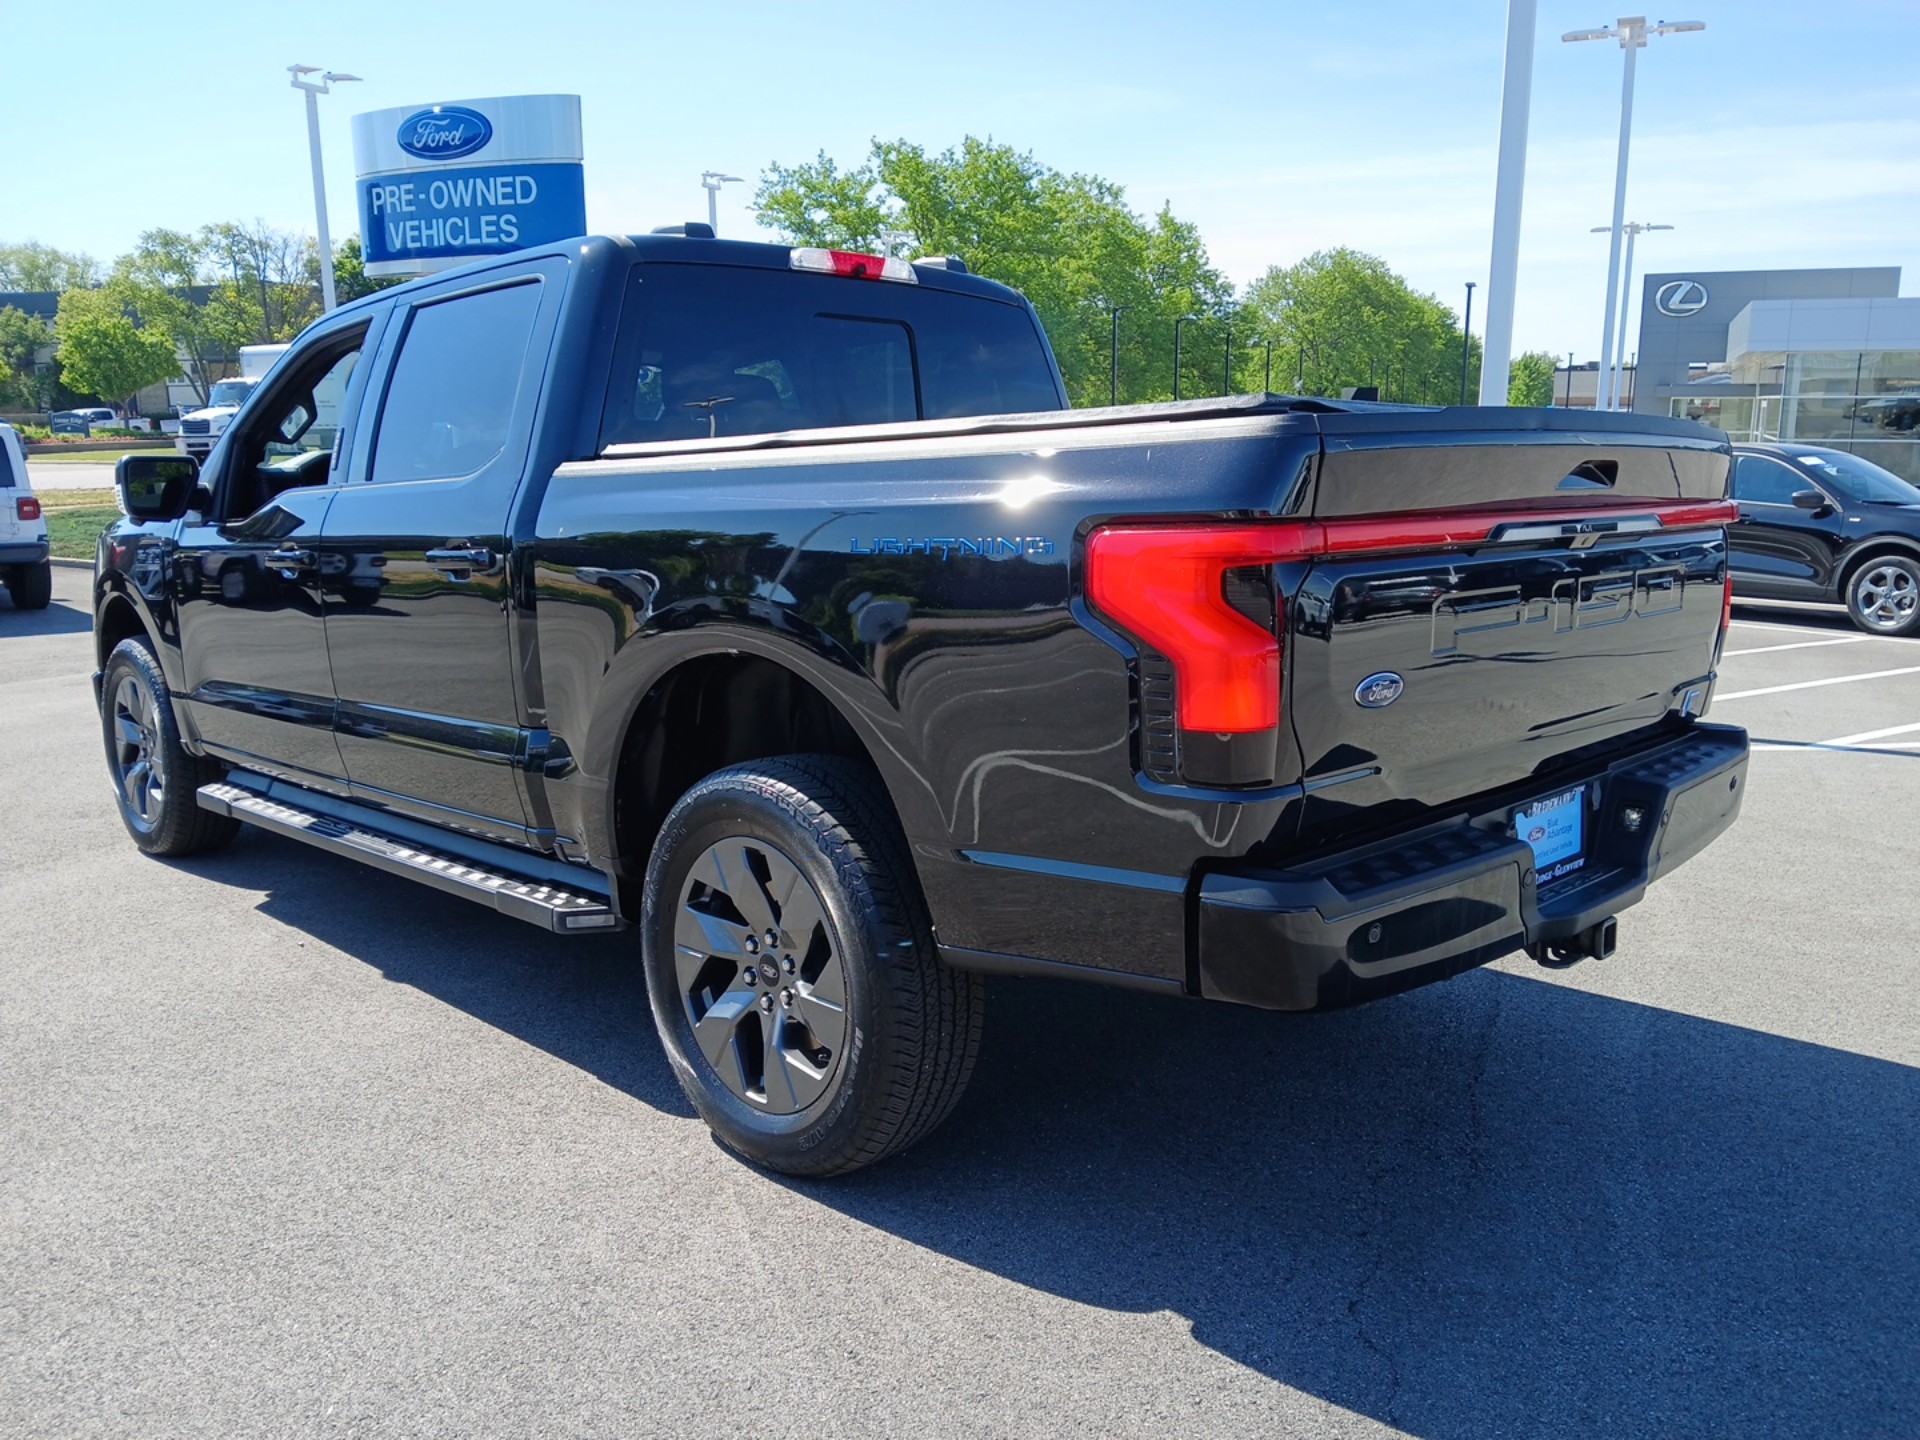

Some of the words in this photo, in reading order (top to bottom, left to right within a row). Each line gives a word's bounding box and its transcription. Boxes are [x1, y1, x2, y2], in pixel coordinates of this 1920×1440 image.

[412, 118, 465, 148] Ford
[371, 175, 538, 216] PRE-OWNED
[388, 213, 519, 253] VEHICLES
[850, 536, 1054, 562] LIGHTNING
[1431, 563, 1687, 656] F-150
[1368, 680, 1396, 701] Ford
[1547, 824, 1573, 840] Advantage
